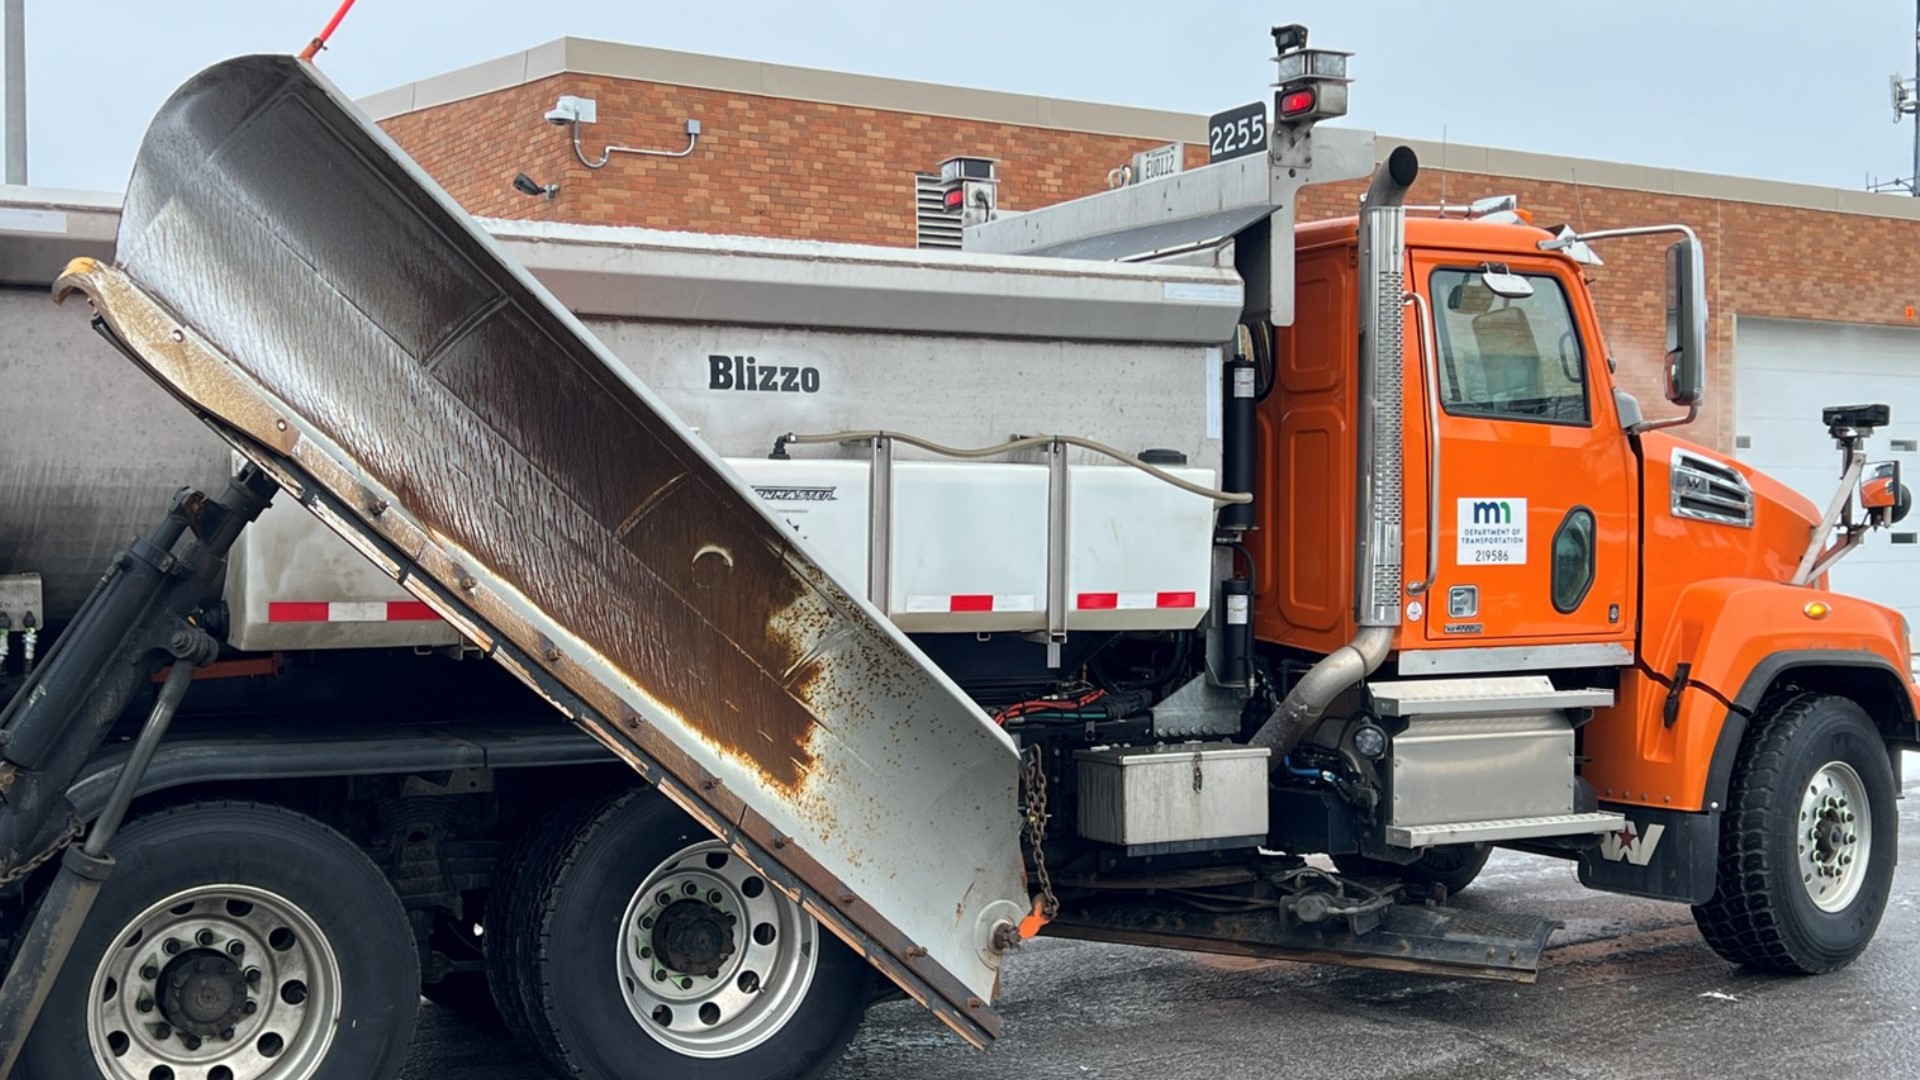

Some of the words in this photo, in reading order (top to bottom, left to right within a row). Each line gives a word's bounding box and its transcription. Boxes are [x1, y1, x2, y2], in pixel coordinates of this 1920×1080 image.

[1211, 114, 1264, 156] 2255
[708, 355, 820, 393] Blizzo
[1475, 549, 1509, 562] 219586
